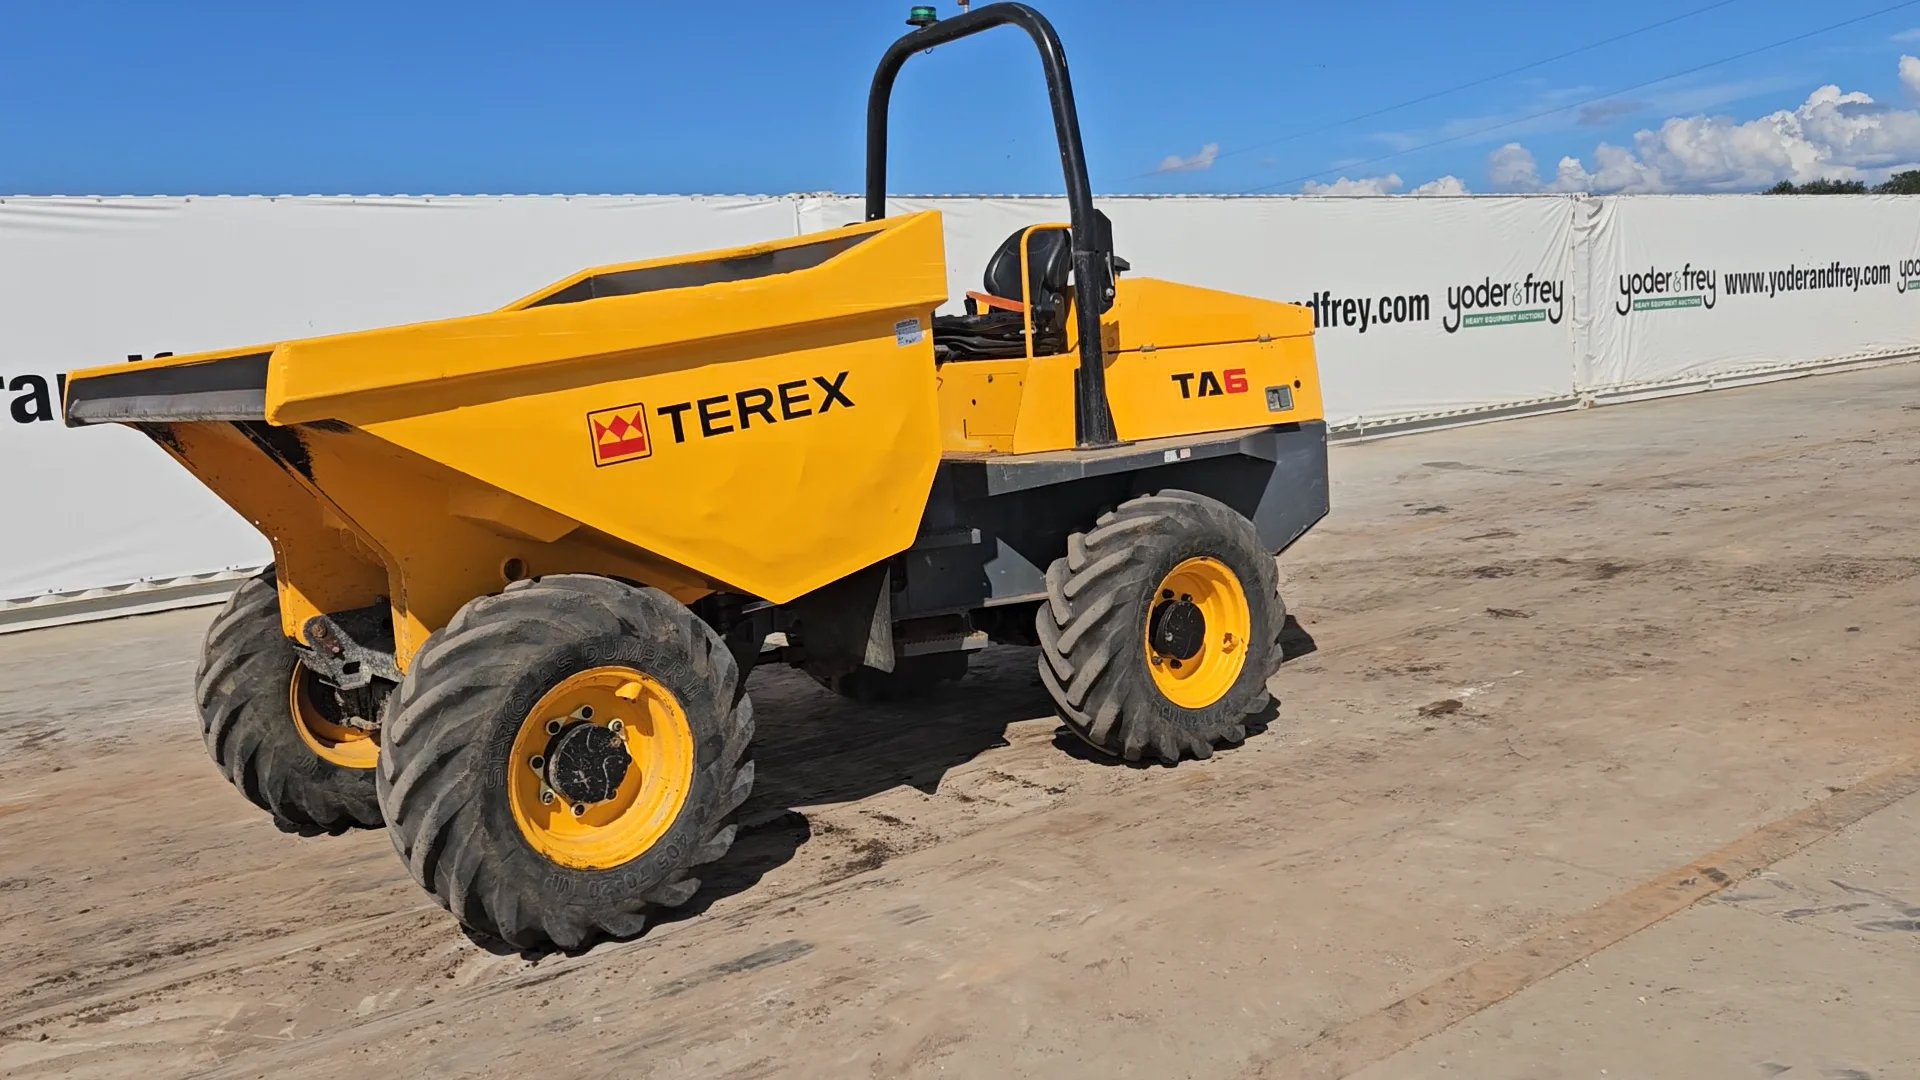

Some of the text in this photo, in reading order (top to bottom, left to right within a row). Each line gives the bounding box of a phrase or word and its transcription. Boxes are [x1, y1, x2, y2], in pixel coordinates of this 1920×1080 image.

[1724, 261, 1891, 298] www.yoderandfrey.com
[1465, 312, 1545, 325] HEAVY EQUIPMENT AUCTIONS
[1171, 368, 1248, 399] TA6
[657, 371, 856, 444] TEREX
[580, 637, 688, 683] DUMPER
